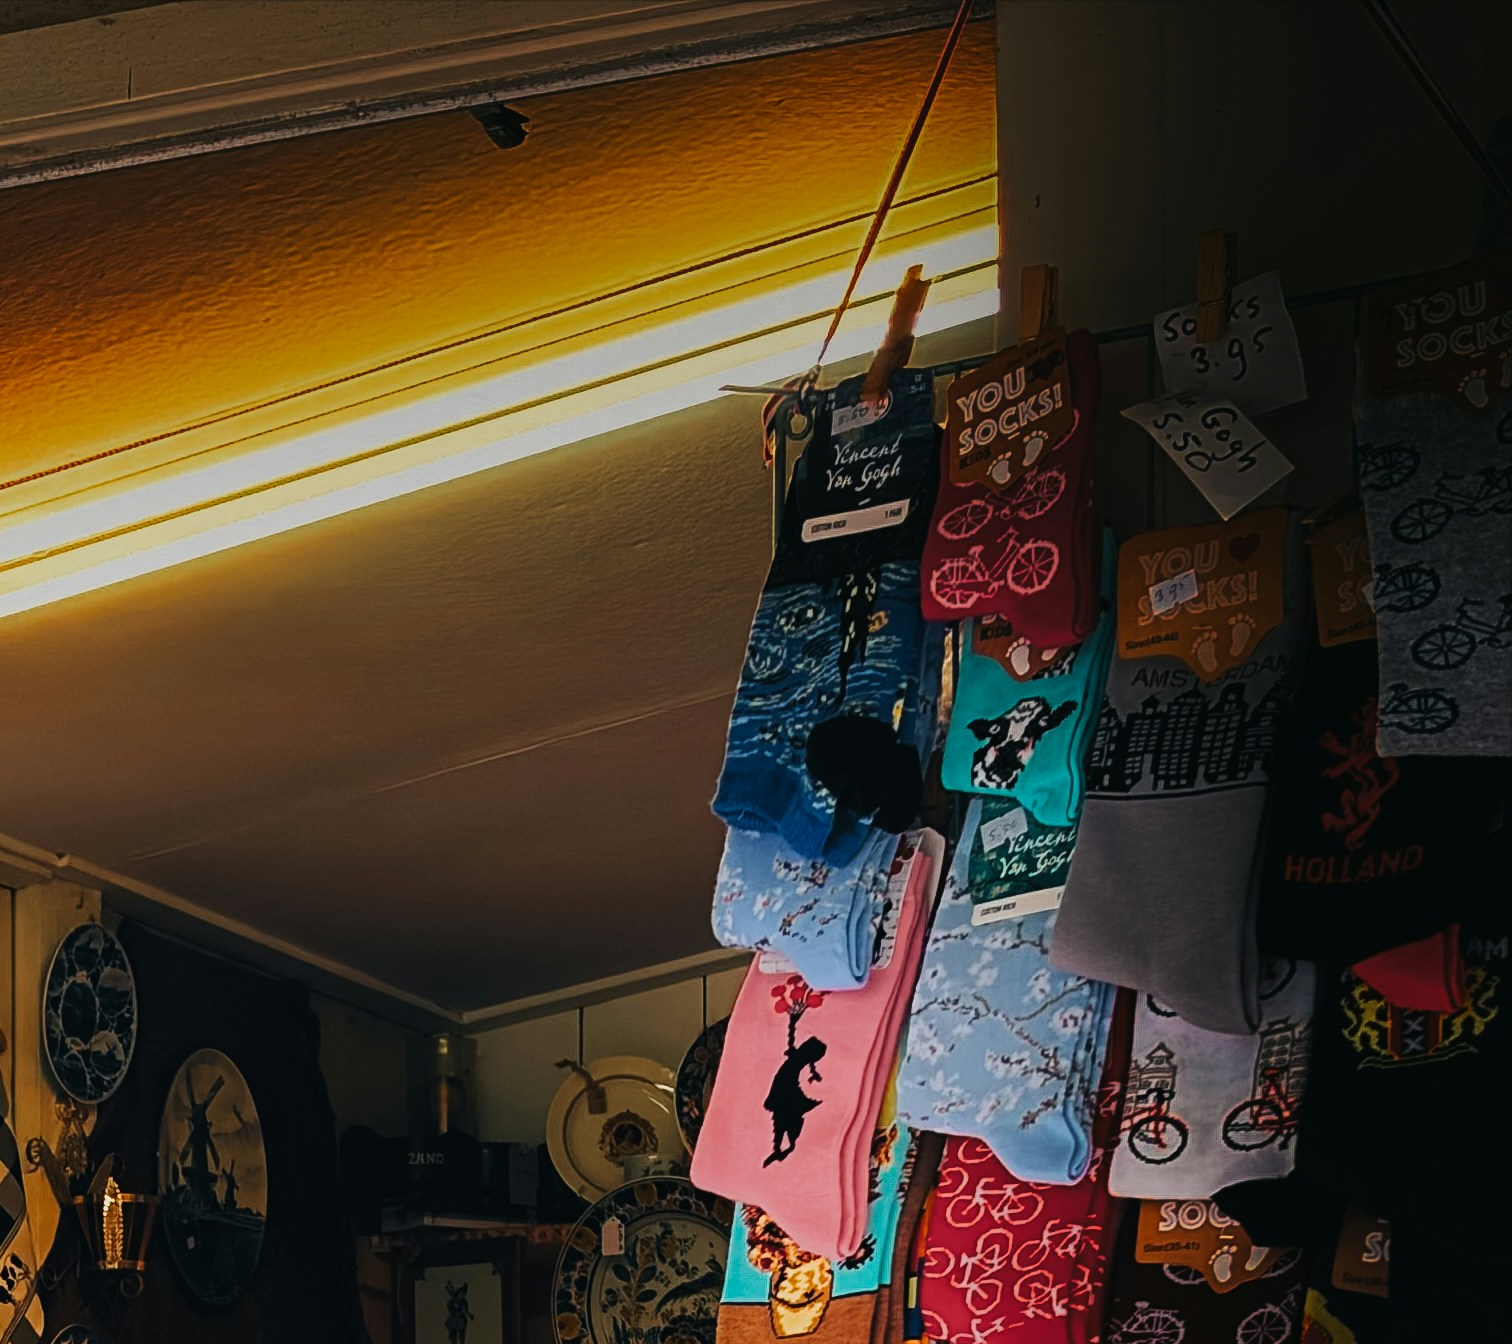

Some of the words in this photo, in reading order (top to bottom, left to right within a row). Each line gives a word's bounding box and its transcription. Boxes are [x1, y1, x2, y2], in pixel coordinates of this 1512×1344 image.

[1395, 280, 1488, 332] YOU
[1189, 327, 1274, 382] 3.95
[954, 365, 1028, 422] YOU
[958, 382, 1064, 456] SOCKS!
[833, 431, 904, 466] Vincent
[1200, 407, 1267, 474] Gogh
[825, 469, 855, 492] Van
[857, 459, 903, 493] Gogh
[1138, 538, 1221, 586] YOU
[1284, 844, 1425, 884] HOLLAND
